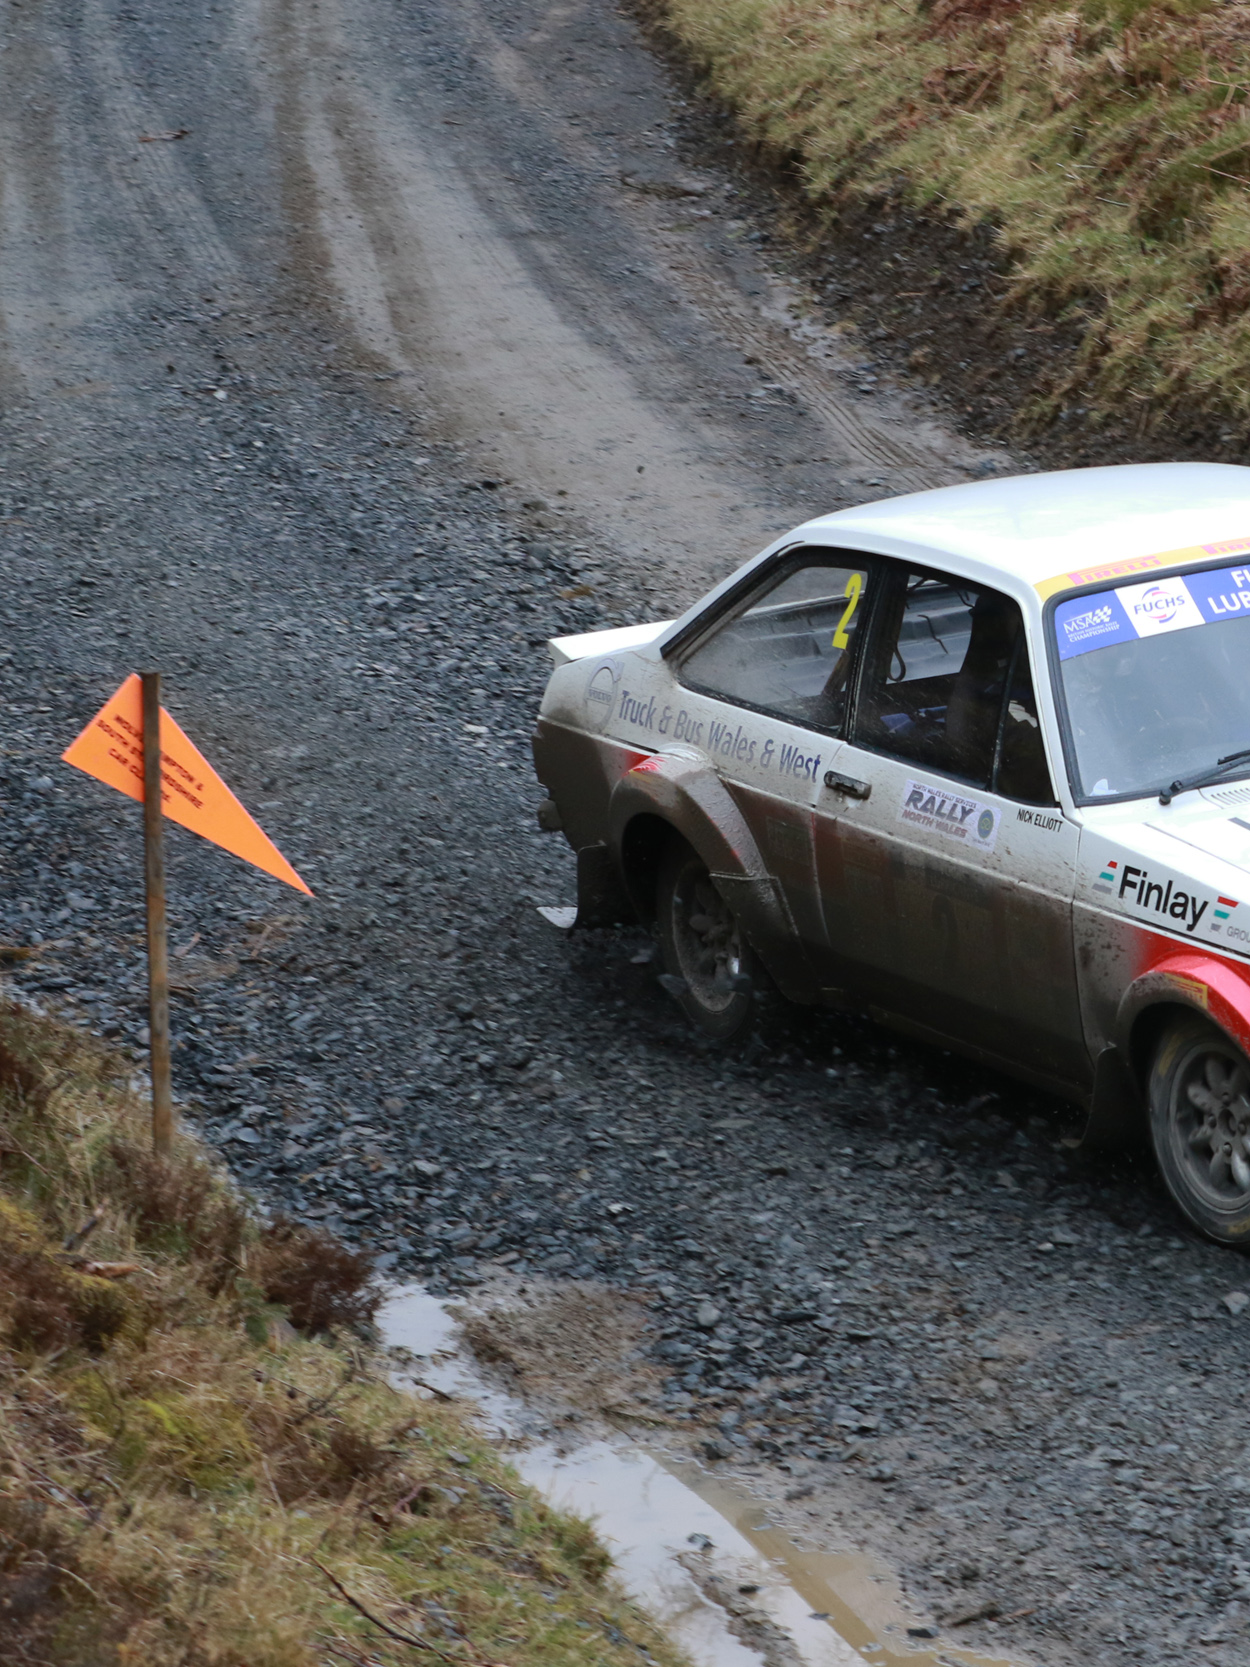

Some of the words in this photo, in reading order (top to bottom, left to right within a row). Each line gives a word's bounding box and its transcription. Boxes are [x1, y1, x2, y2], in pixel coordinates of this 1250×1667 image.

[832, 573, 862, 650] 2
[1133, 595, 1186, 615] FUCHS
[1063, 615, 1097, 634] MSA
[618, 690, 655, 731] Truck
[658, 705, 671, 735] &
[674, 709, 703, 745] Bus
[708, 720, 757, 759] Wales
[760, 738, 775, 769] &
[778, 743, 821, 783] West
[904, 789, 974, 825] RALLY
[1017, 808, 1034, 824] NICK
[1034, 813, 1064, 833] ELLIOTT
[902, 809, 934, 829] NORTH
[935, 818, 968, 839] WALES
[1118, 864, 1209, 932] Finlay
